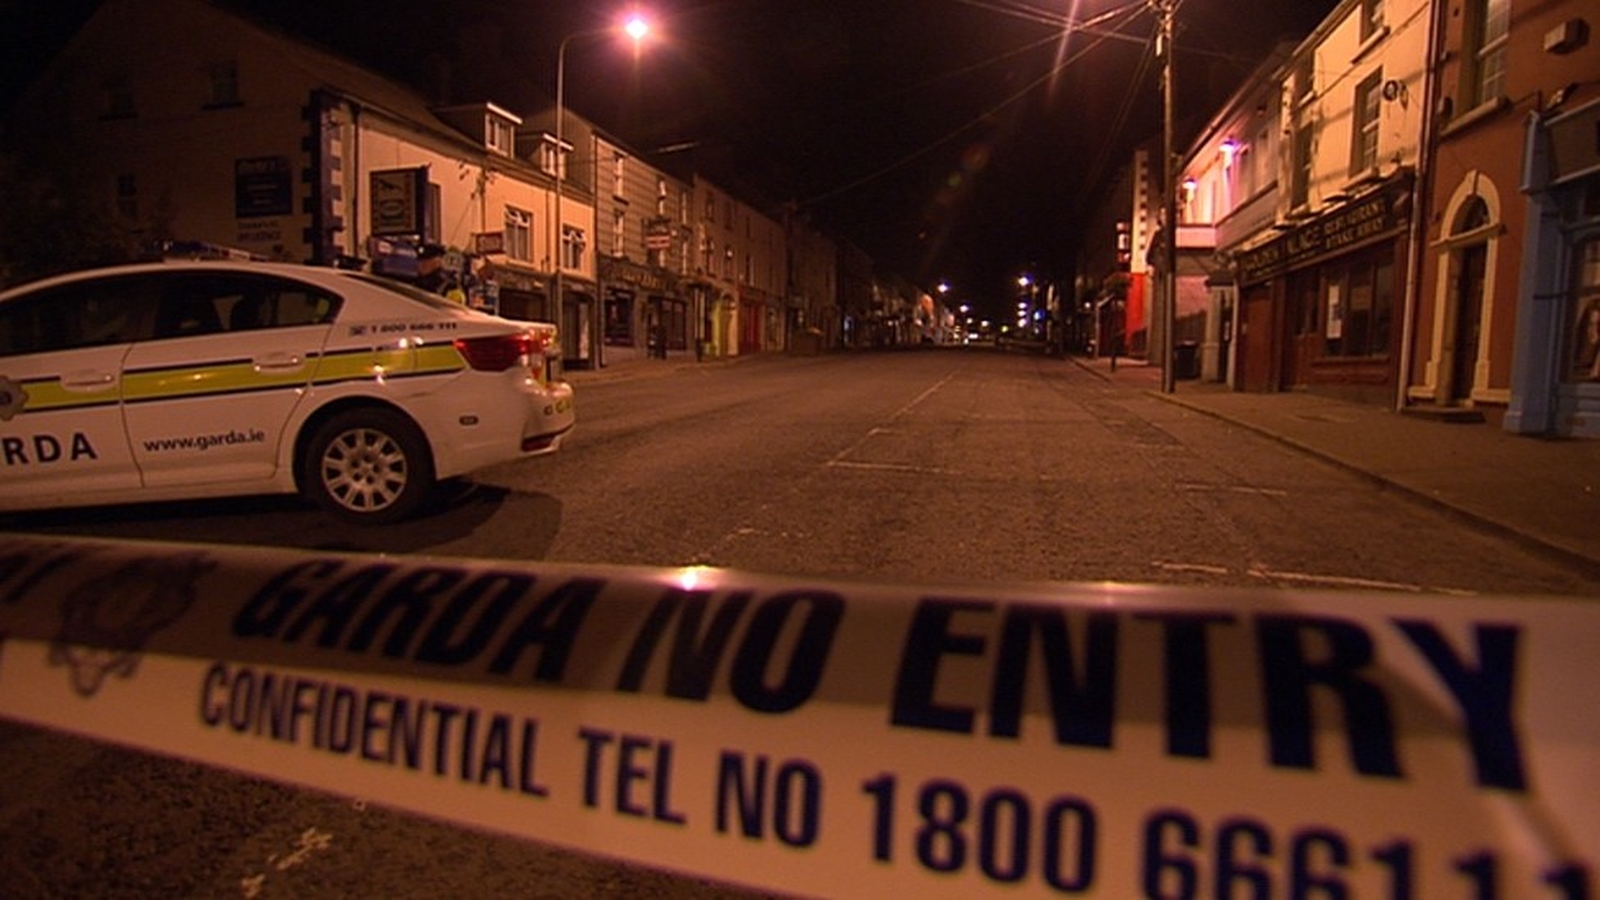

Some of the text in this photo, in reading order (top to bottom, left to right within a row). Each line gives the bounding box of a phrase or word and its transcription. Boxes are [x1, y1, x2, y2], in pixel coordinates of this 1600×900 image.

[143, 427, 265, 451] www.garda.ie
[200, 658, 549, 798] CONFIDENTIAL
[578, 727, 687, 825] TEL
[715, 750, 821, 847] NO
[861, 773, 1097, 894] 1800
[231, 559, 607, 683] GARDA
[615, 586, 846, 713] NO
[890, 597, 1527, 792] ENTRY
